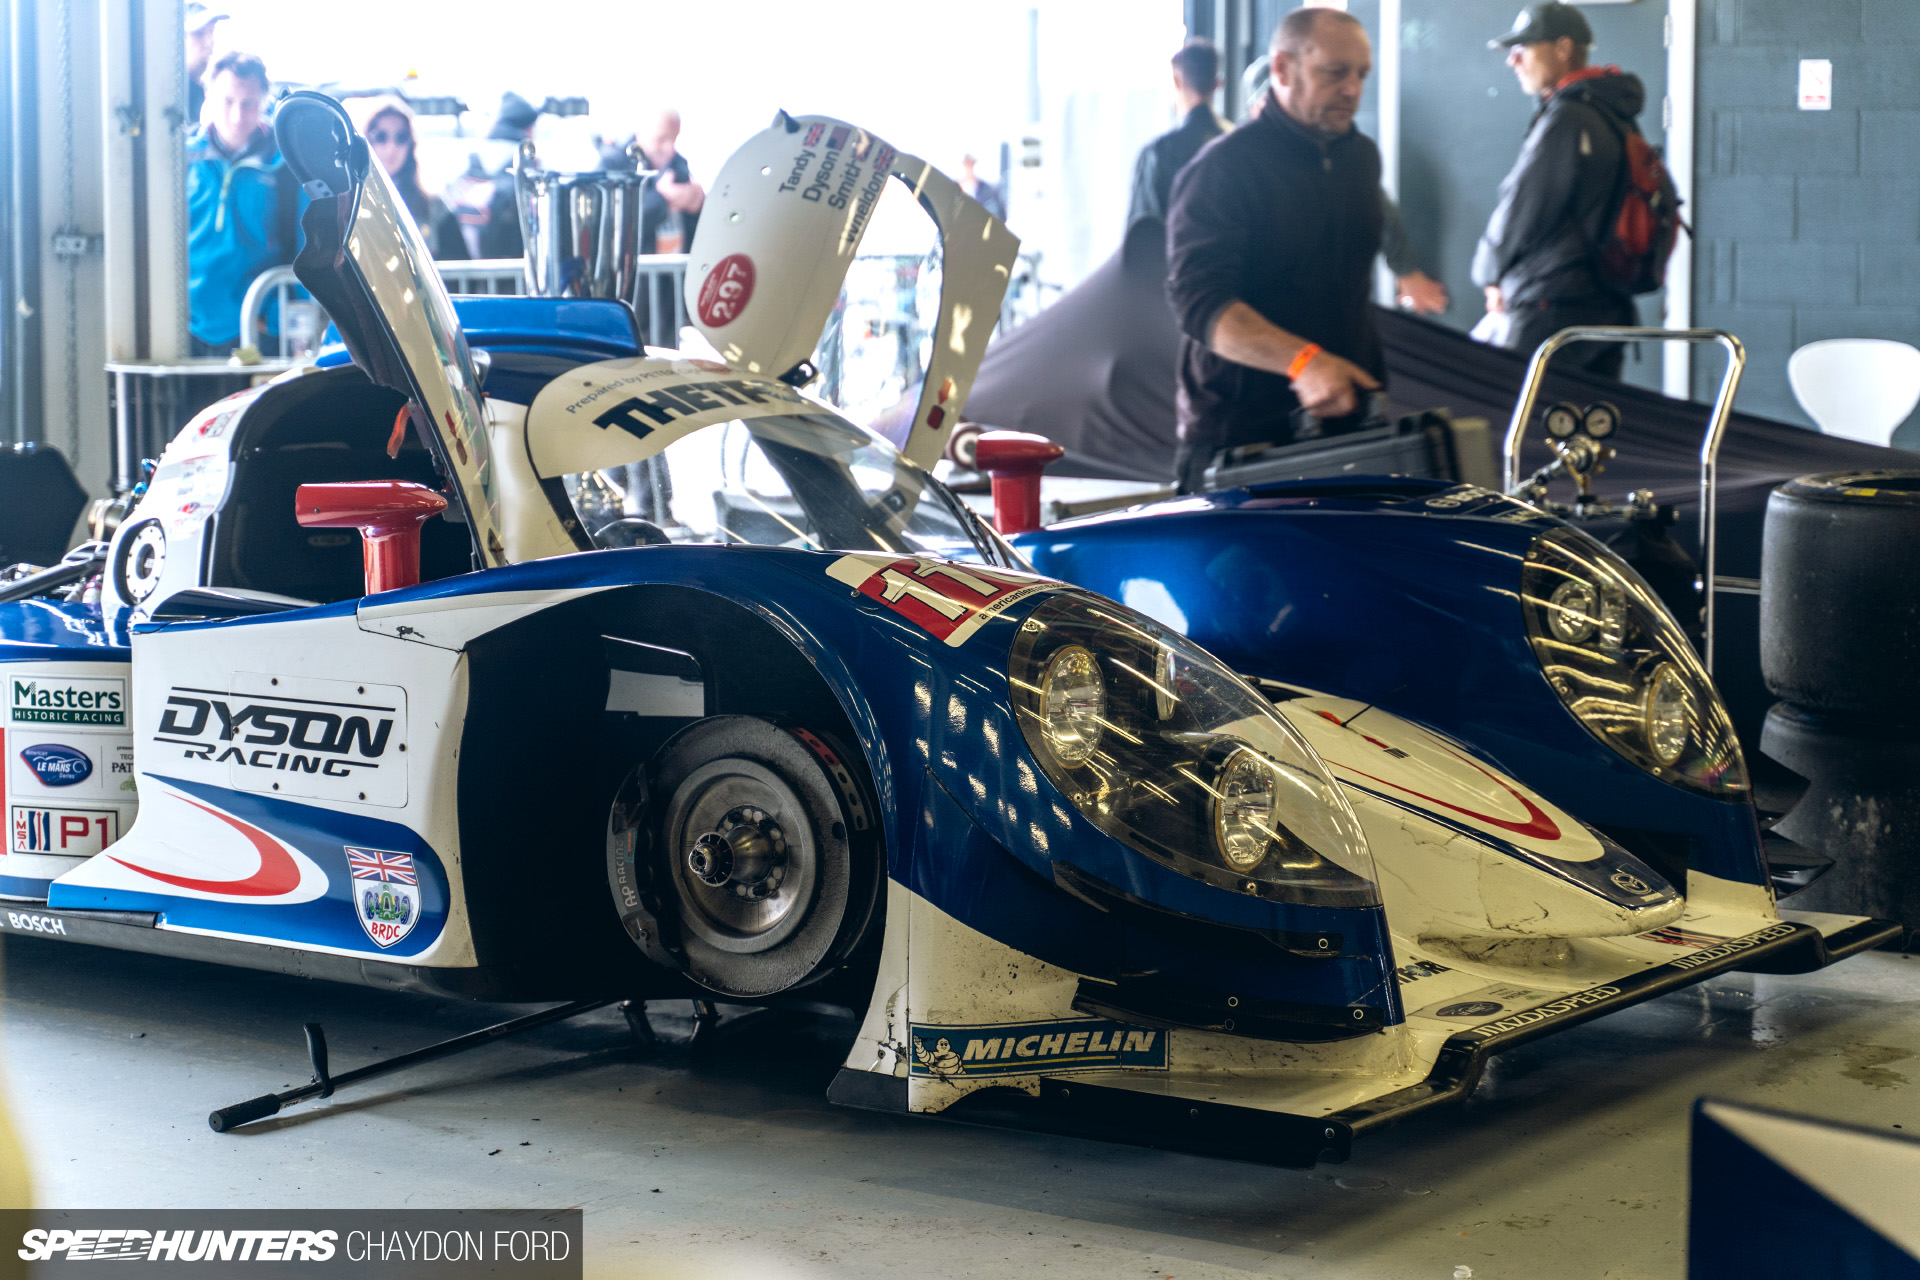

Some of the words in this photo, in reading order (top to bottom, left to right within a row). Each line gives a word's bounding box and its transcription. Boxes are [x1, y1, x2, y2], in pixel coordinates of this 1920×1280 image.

[778, 149, 816, 193] Tandy
[801, 150, 840, 203] Dyson
[712, 263, 746, 319] 297
[566, 380, 624, 414] Prepared
[14, 681, 121, 709] Masters
[14, 711, 68, 721] HISTORIC
[74, 712, 121, 723] RACING
[158, 695, 394, 758] DYSON
[37, 762, 46, 772] LE
[47, 762, 71, 773] MANS
[154, 736, 380, 778] RACING
[60, 816, 108, 851] P1
[8, 912, 67, 936] BOSCH
[371, 921, 401, 940] BRDC
[1669, 924, 1797, 970] MAZDASPEED
[1472, 985, 1622, 1038] MAZDASPEED
[963, 1031, 1156, 1061] MICHELIN
